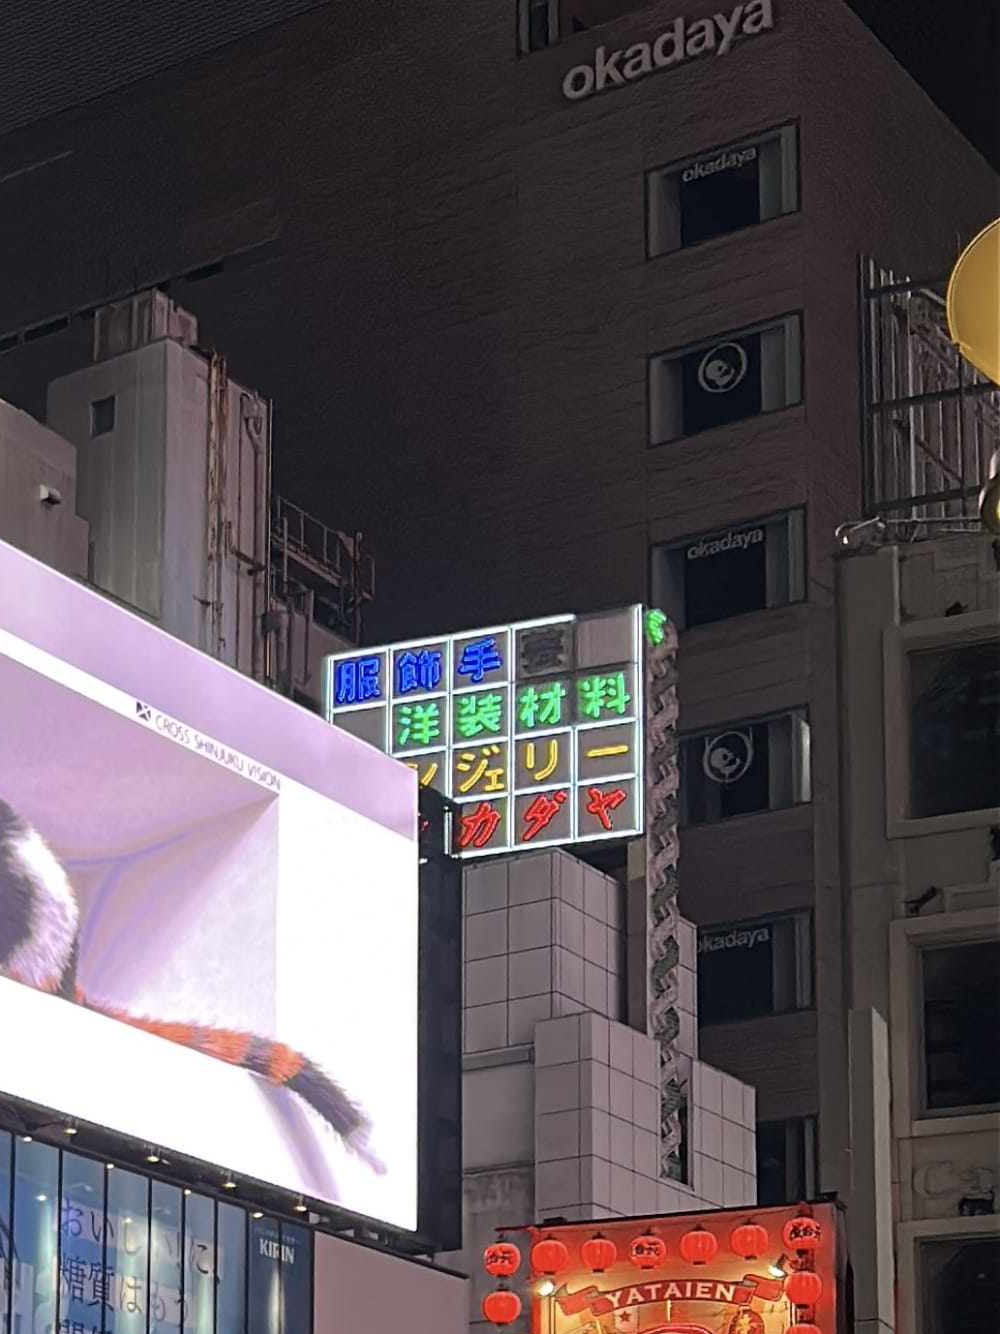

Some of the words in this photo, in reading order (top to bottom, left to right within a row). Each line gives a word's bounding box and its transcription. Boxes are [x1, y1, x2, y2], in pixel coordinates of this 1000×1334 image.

[562, 0, 774, 100] okadaya
[682, 147, 758, 182] okadaya
[687, 526, 765, 560] okadaya
[399, 672, 631, 746] 洋装材料
[259, 1239, 295, 1265] KIRIN
[605, 1282, 736, 1308] YATAIEN
